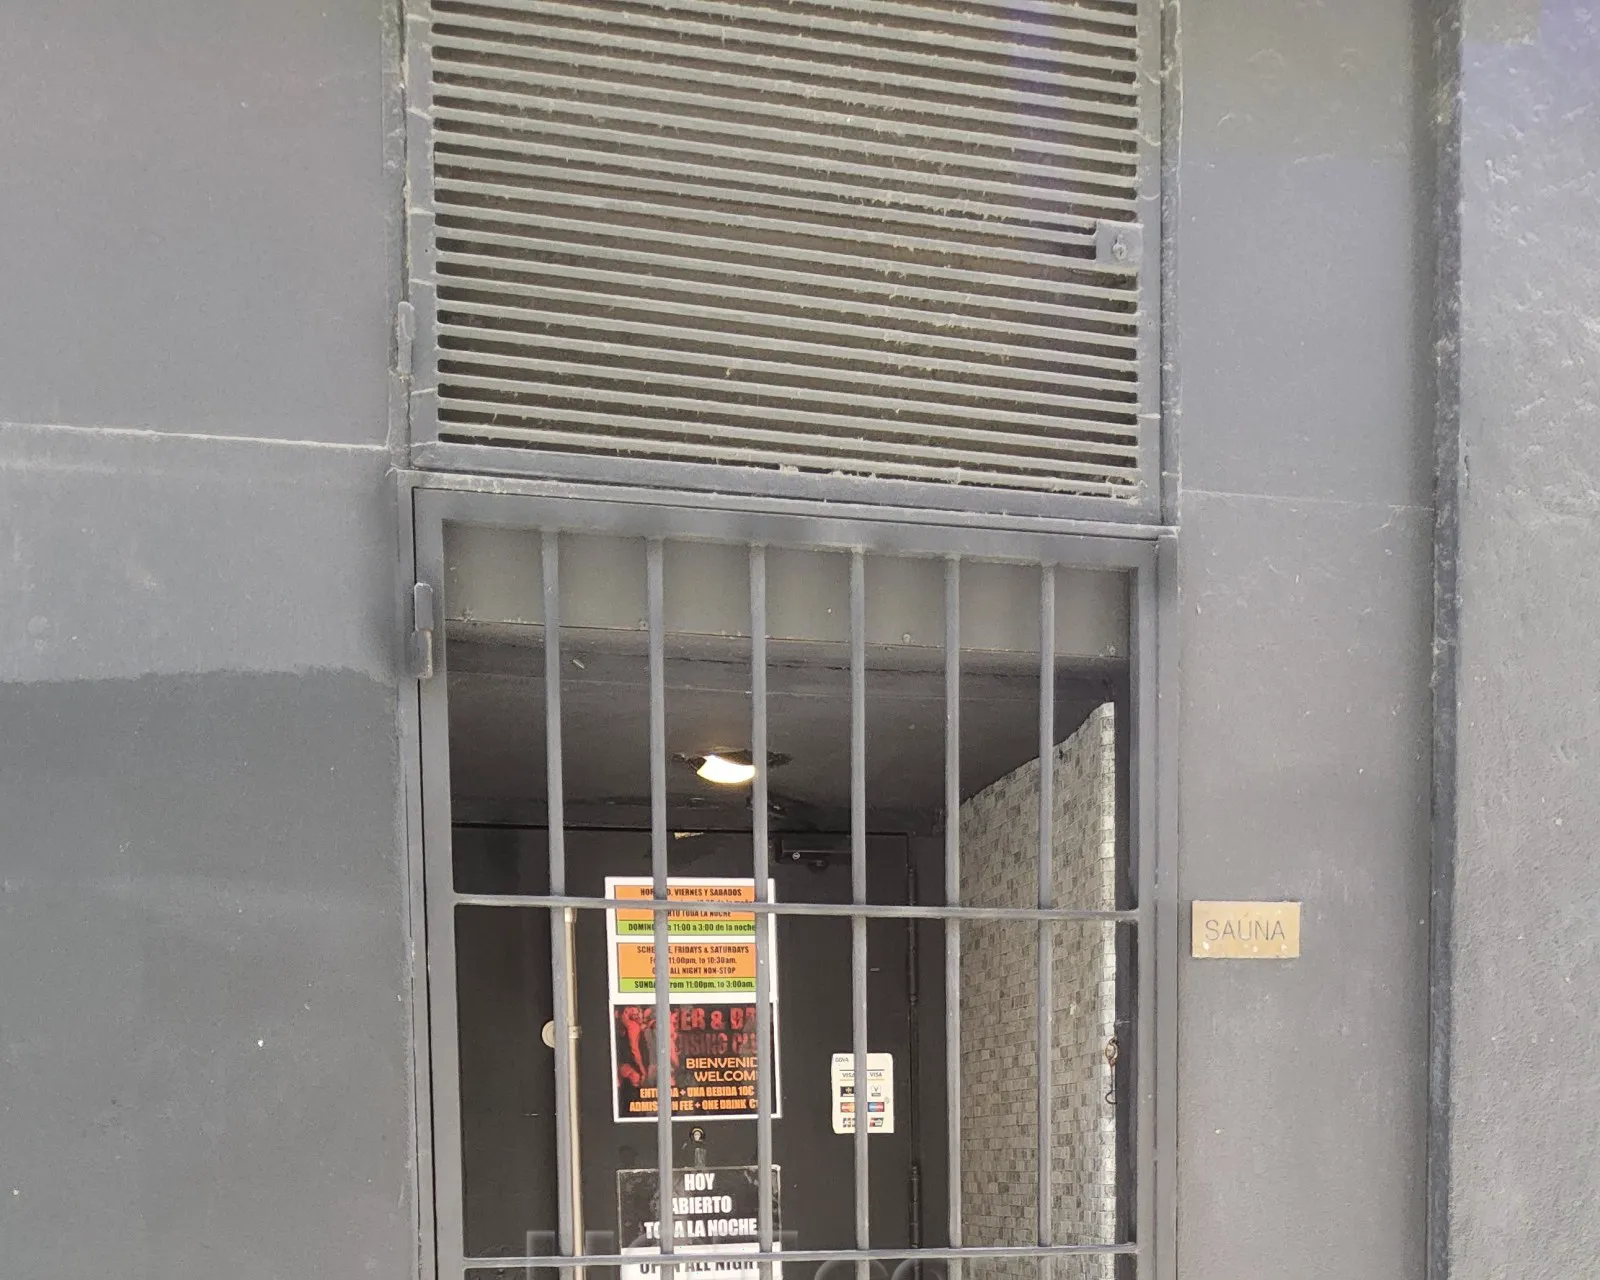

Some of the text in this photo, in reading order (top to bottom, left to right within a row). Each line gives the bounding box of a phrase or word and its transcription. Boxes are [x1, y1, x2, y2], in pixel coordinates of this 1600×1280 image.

[674, 888, 703, 897] VIERNES
[703, 888, 709, 897] Y
[710, 888, 742, 897] SABADOS
[673, 923, 690, 931] 11:00
[698, 923, 714, 931] 3:00
[715, 923, 724, 931] de
[725, 923, 733, 931] la
[674, 946, 702, 954] FRIDAYS
[710, 946, 749, 954] SATURDAYS
[698, 956, 706, 964] to
[717, 980, 725, 988] to
[710, 1010, 725, 1030] &
[685, 1057, 758, 1069] BIENVENID
[694, 1070, 758, 1082] WELCOM
[686, 1086, 705, 1098] UNA
[705, 1086, 738, 1097] BEBIDA
[679, 1100, 694, 1111] FEE
[701, 1099, 719, 1111] ONE
[719, 1098, 747, 1110] DRINK
[683, 1172, 715, 1191] HOY
[643, 1217, 758, 1239] TOA LA NOCHE
